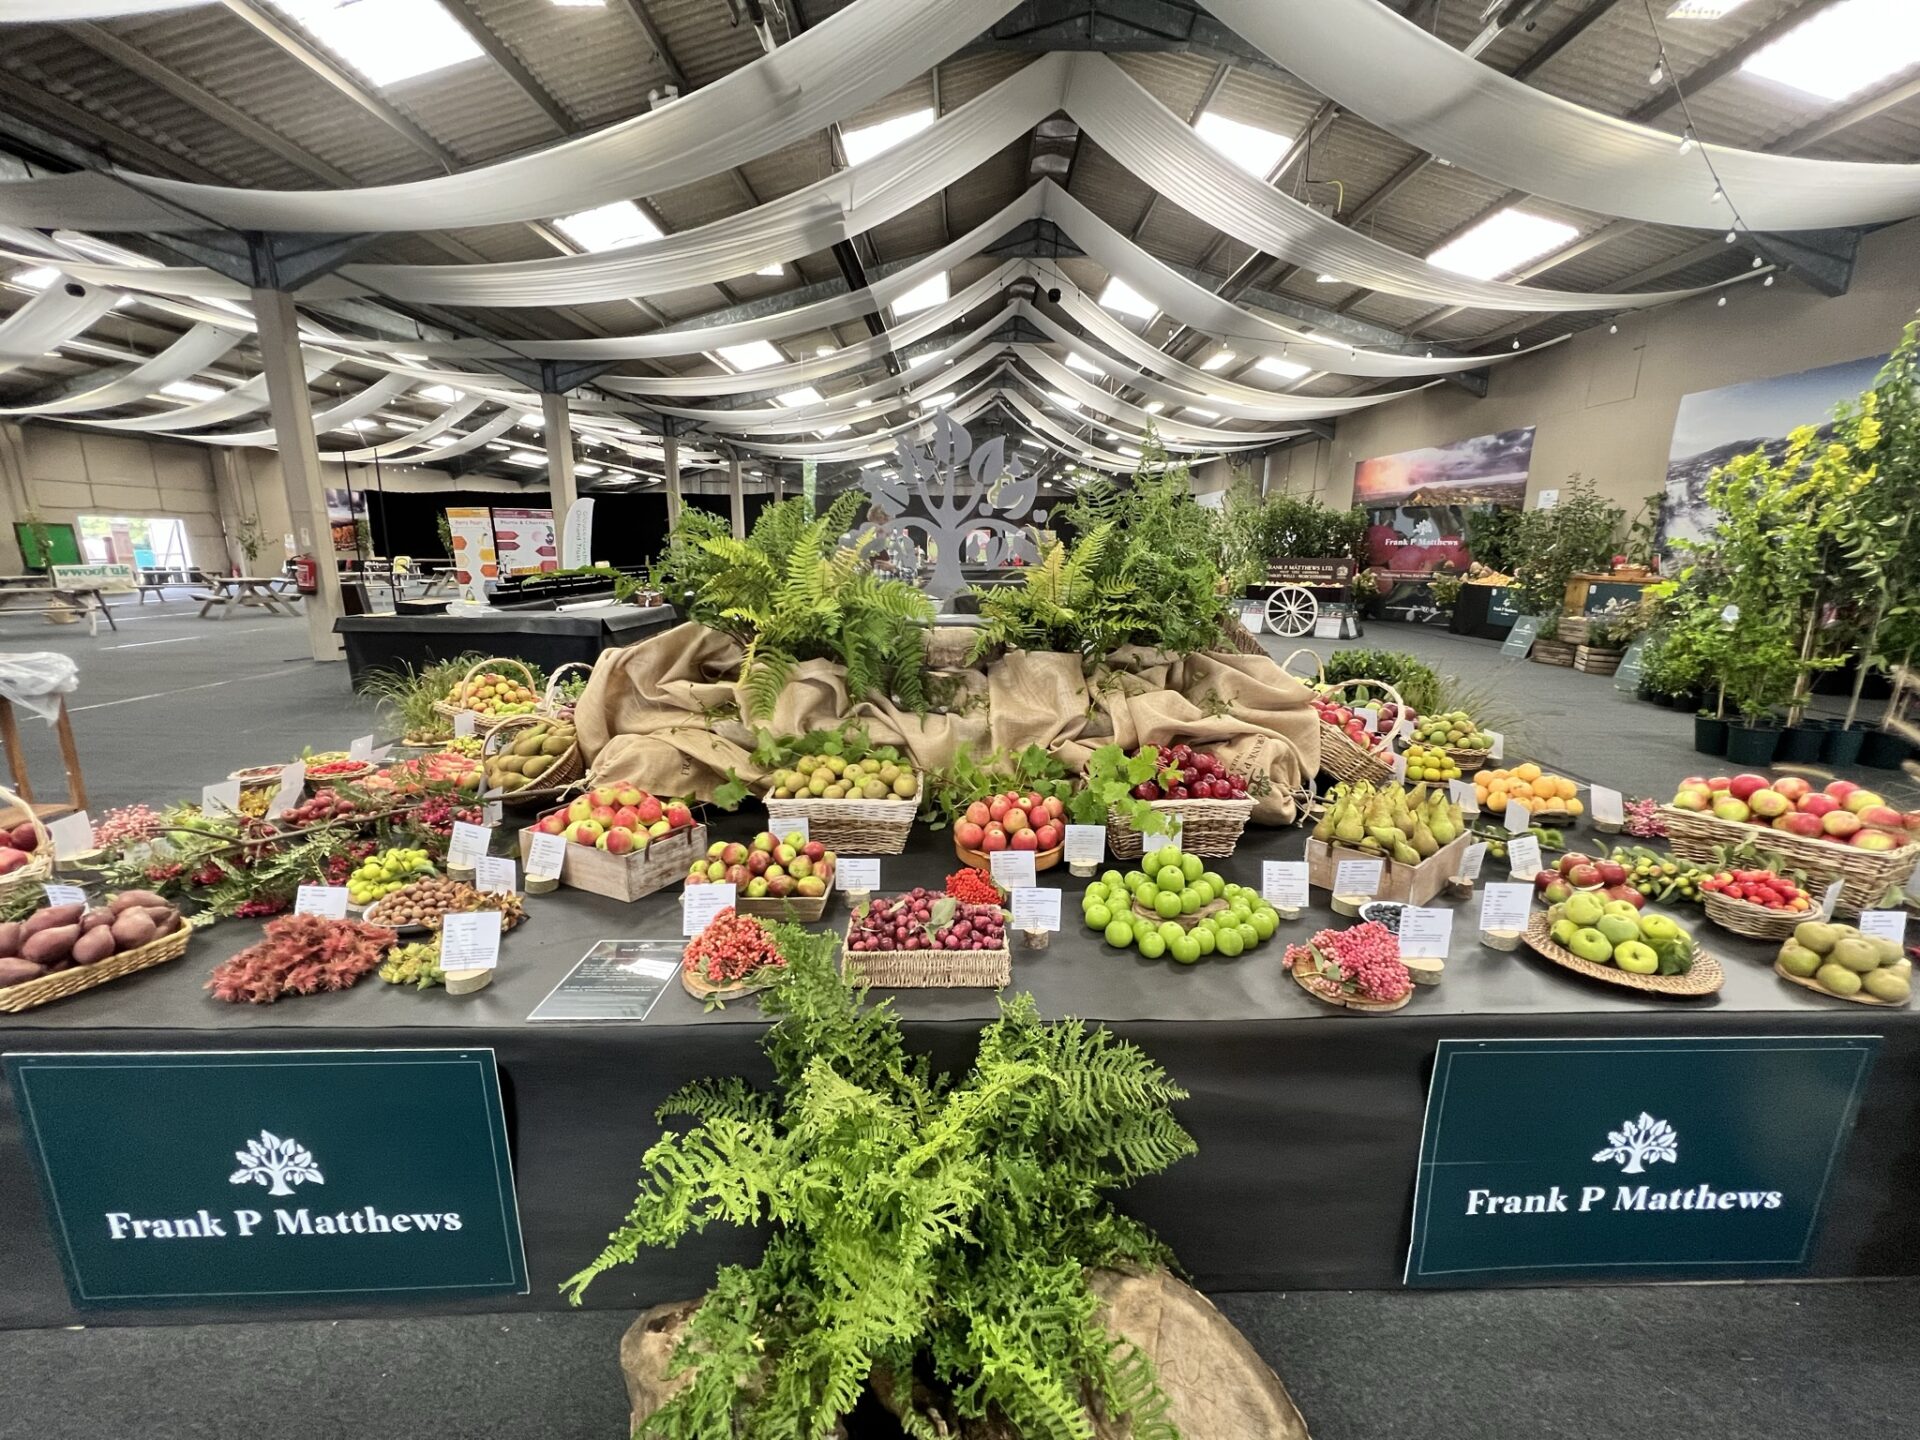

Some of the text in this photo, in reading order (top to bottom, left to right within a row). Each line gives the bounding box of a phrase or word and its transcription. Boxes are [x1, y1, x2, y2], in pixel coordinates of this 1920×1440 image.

[1385, 538, 1408, 546] Frank
[1419, 538, 1459, 546] Matthews
[57, 565, 129, 577] wwoof uk
[1465, 1184, 1783, 1216] Frank P Matthews
[105, 1206, 463, 1240] Frank P Matthews
